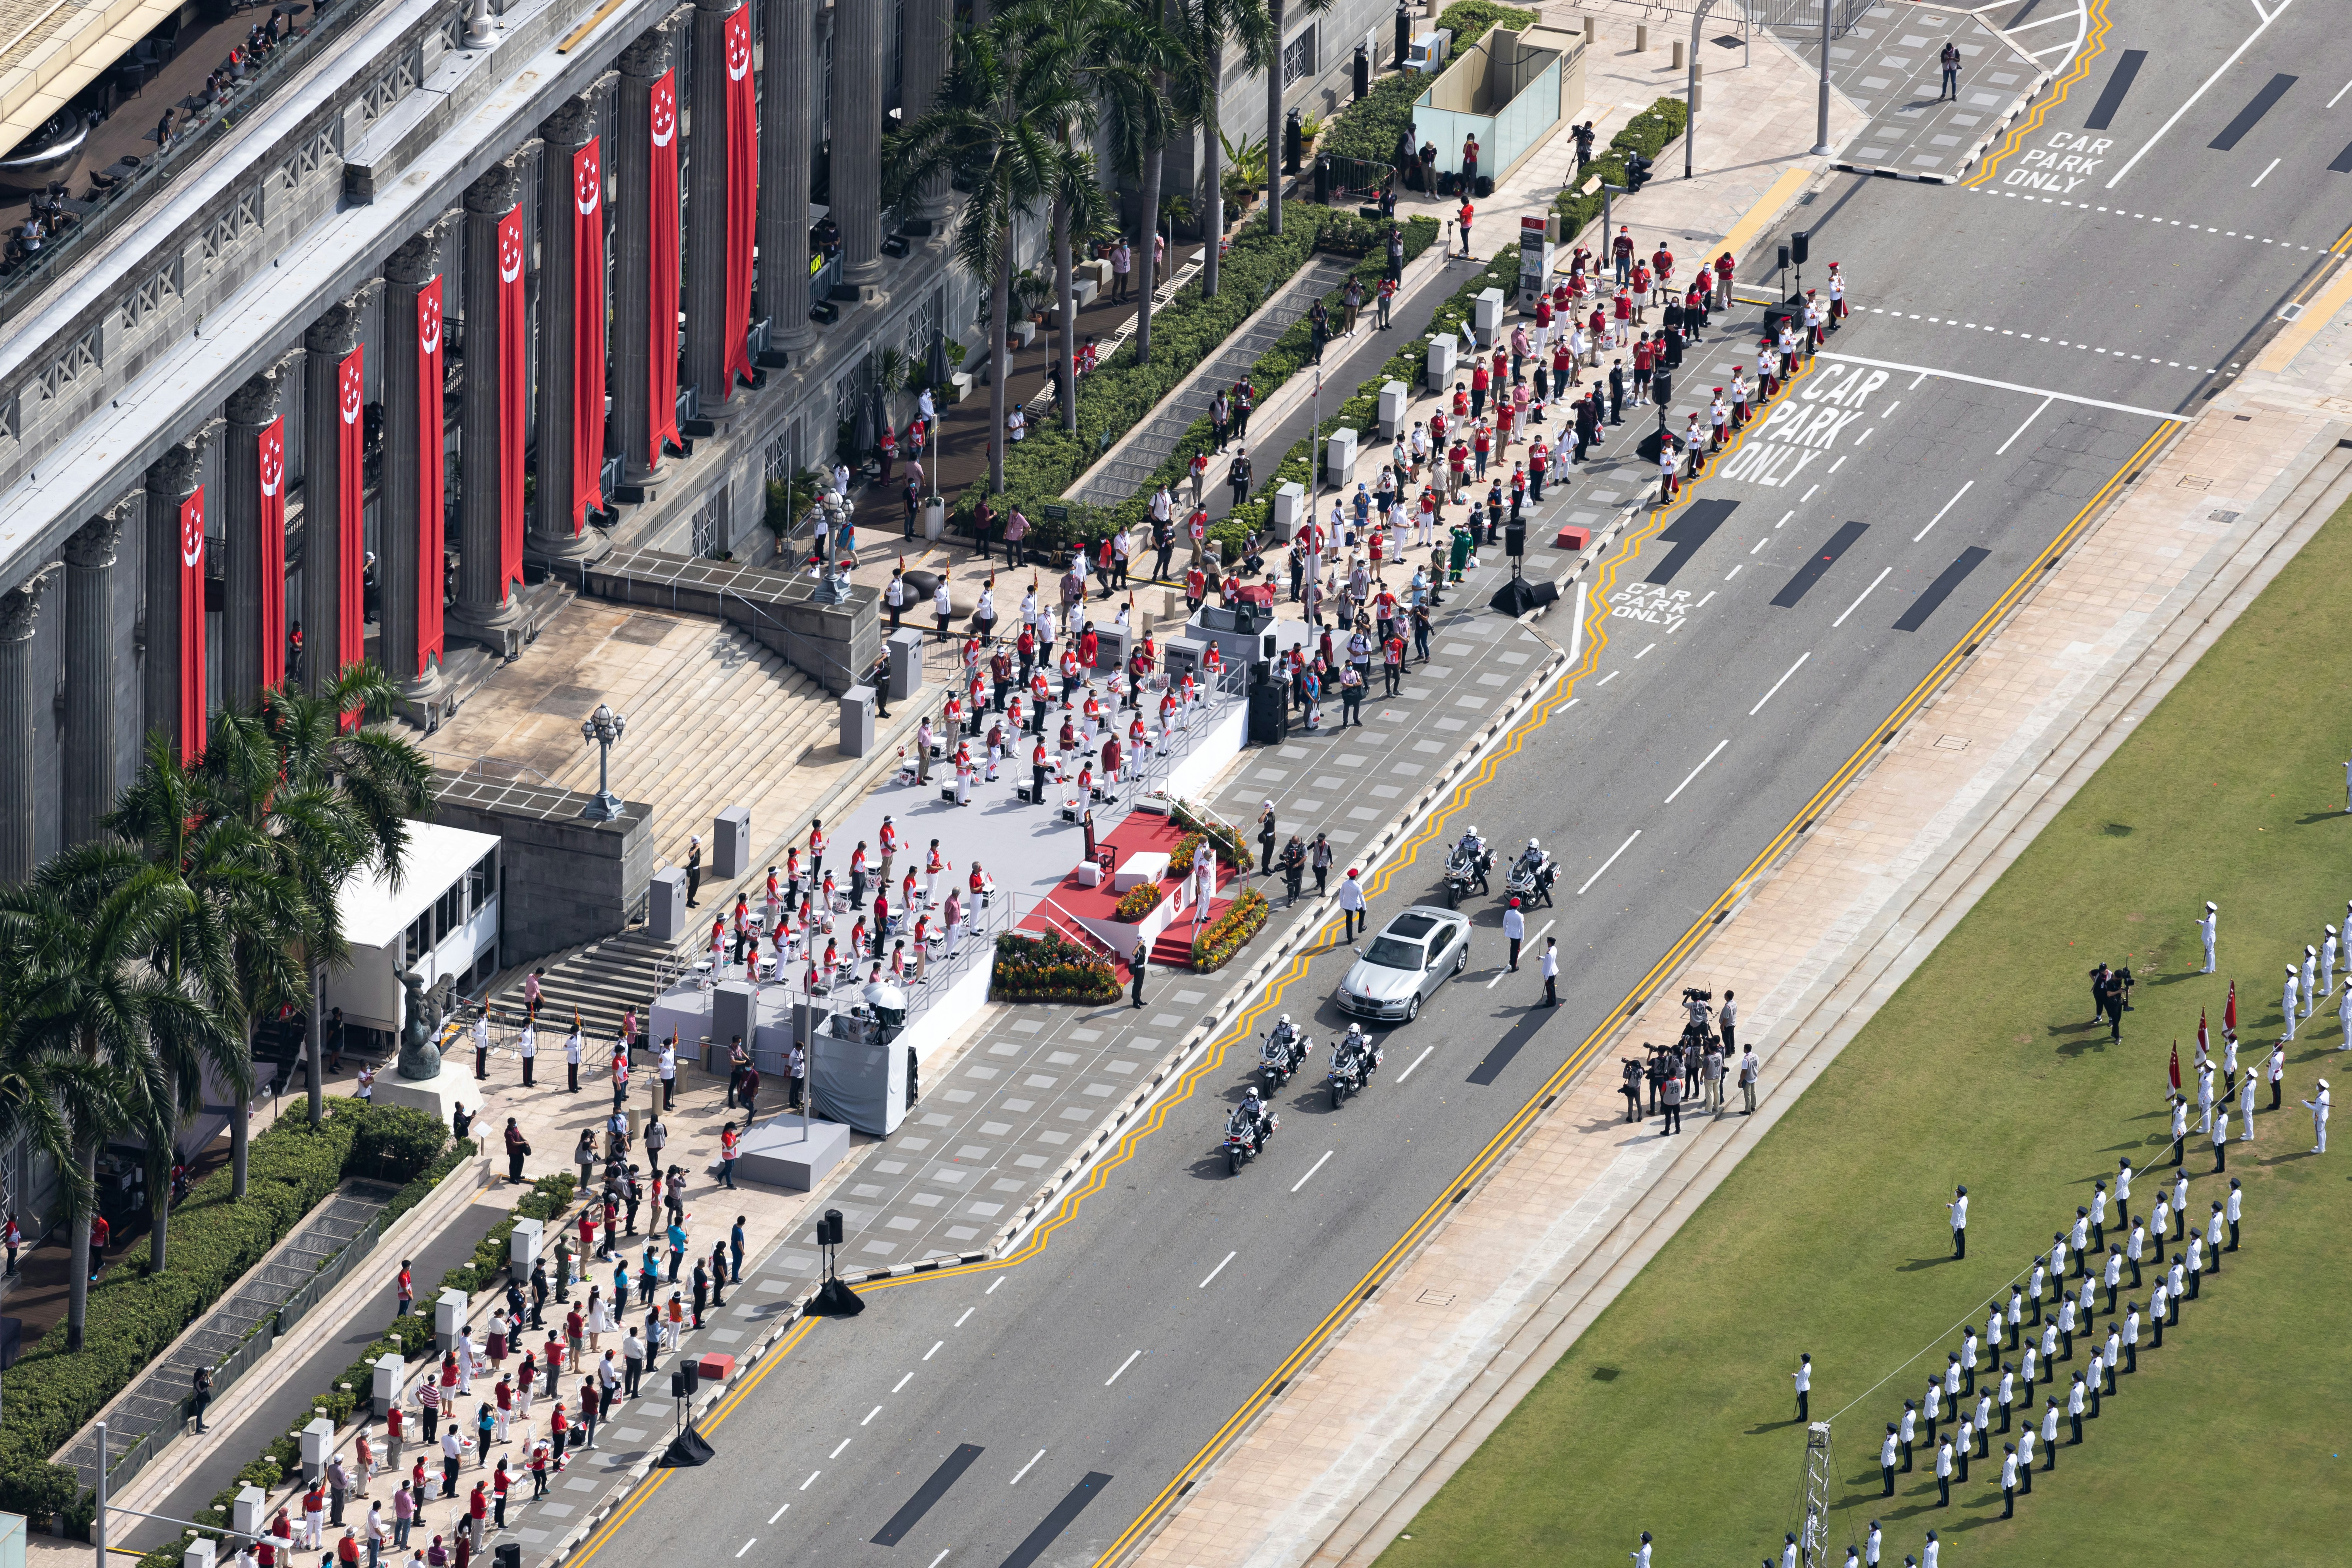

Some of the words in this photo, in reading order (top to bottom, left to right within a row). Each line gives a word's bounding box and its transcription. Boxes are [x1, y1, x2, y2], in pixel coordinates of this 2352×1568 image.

[2047, 132, 2113, 155] CAR
[2020, 149, 2104, 175] PARK
[2003, 169, 2085, 193] ONLY
[1801, 364, 1889, 408] CAR
[1752, 400, 1864, 449] PARK
[1720, 442, 1822, 487] ONLY
[1608, 592, 1693, 614] PARK
[1625, 583, 1691, 601] CAR
[1611, 606, 1682, 625] ONLY
[1670, 1086, 1679, 1094] 25
